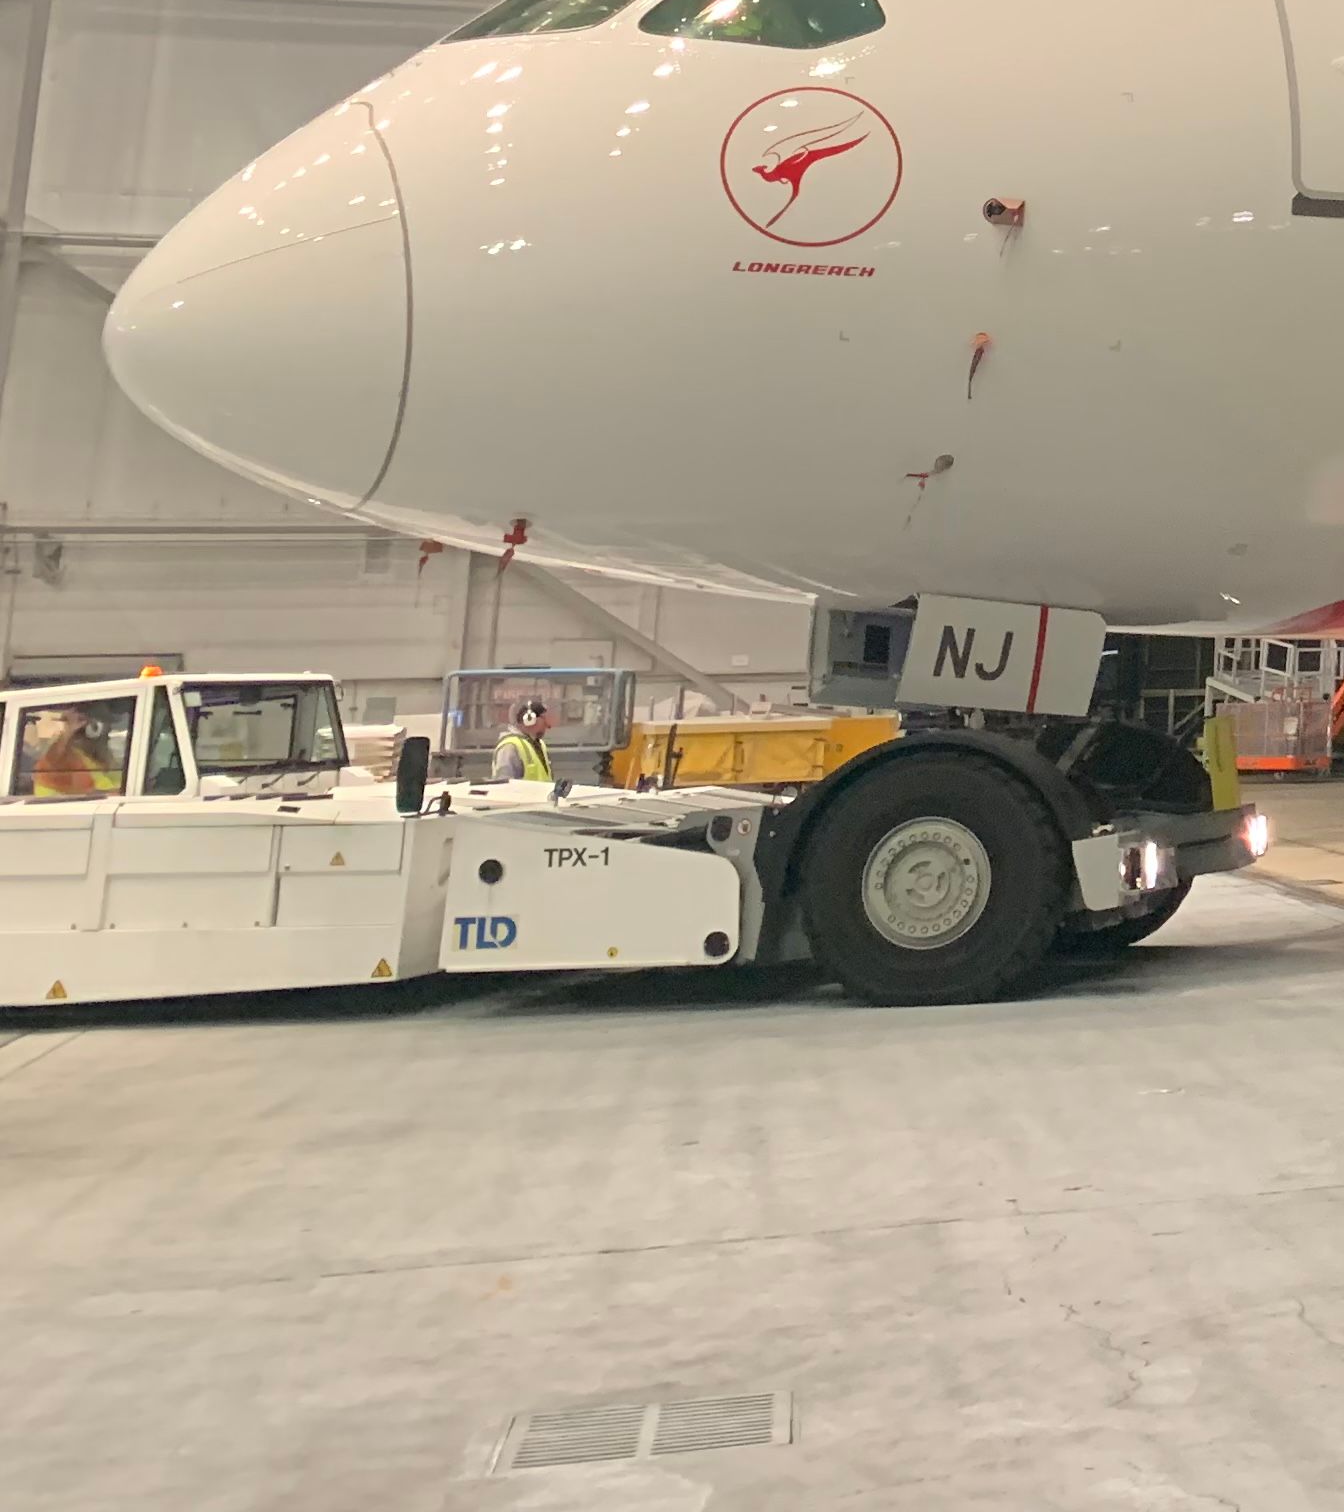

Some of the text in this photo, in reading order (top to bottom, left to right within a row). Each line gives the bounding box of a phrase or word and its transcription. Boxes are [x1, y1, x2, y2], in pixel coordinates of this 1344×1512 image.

[732, 260, 875, 277] LONGREACH
[932, 625, 1014, 682] NJ
[543, 847, 610, 868] TPX-1
[454, 916, 518, 950] TLD
